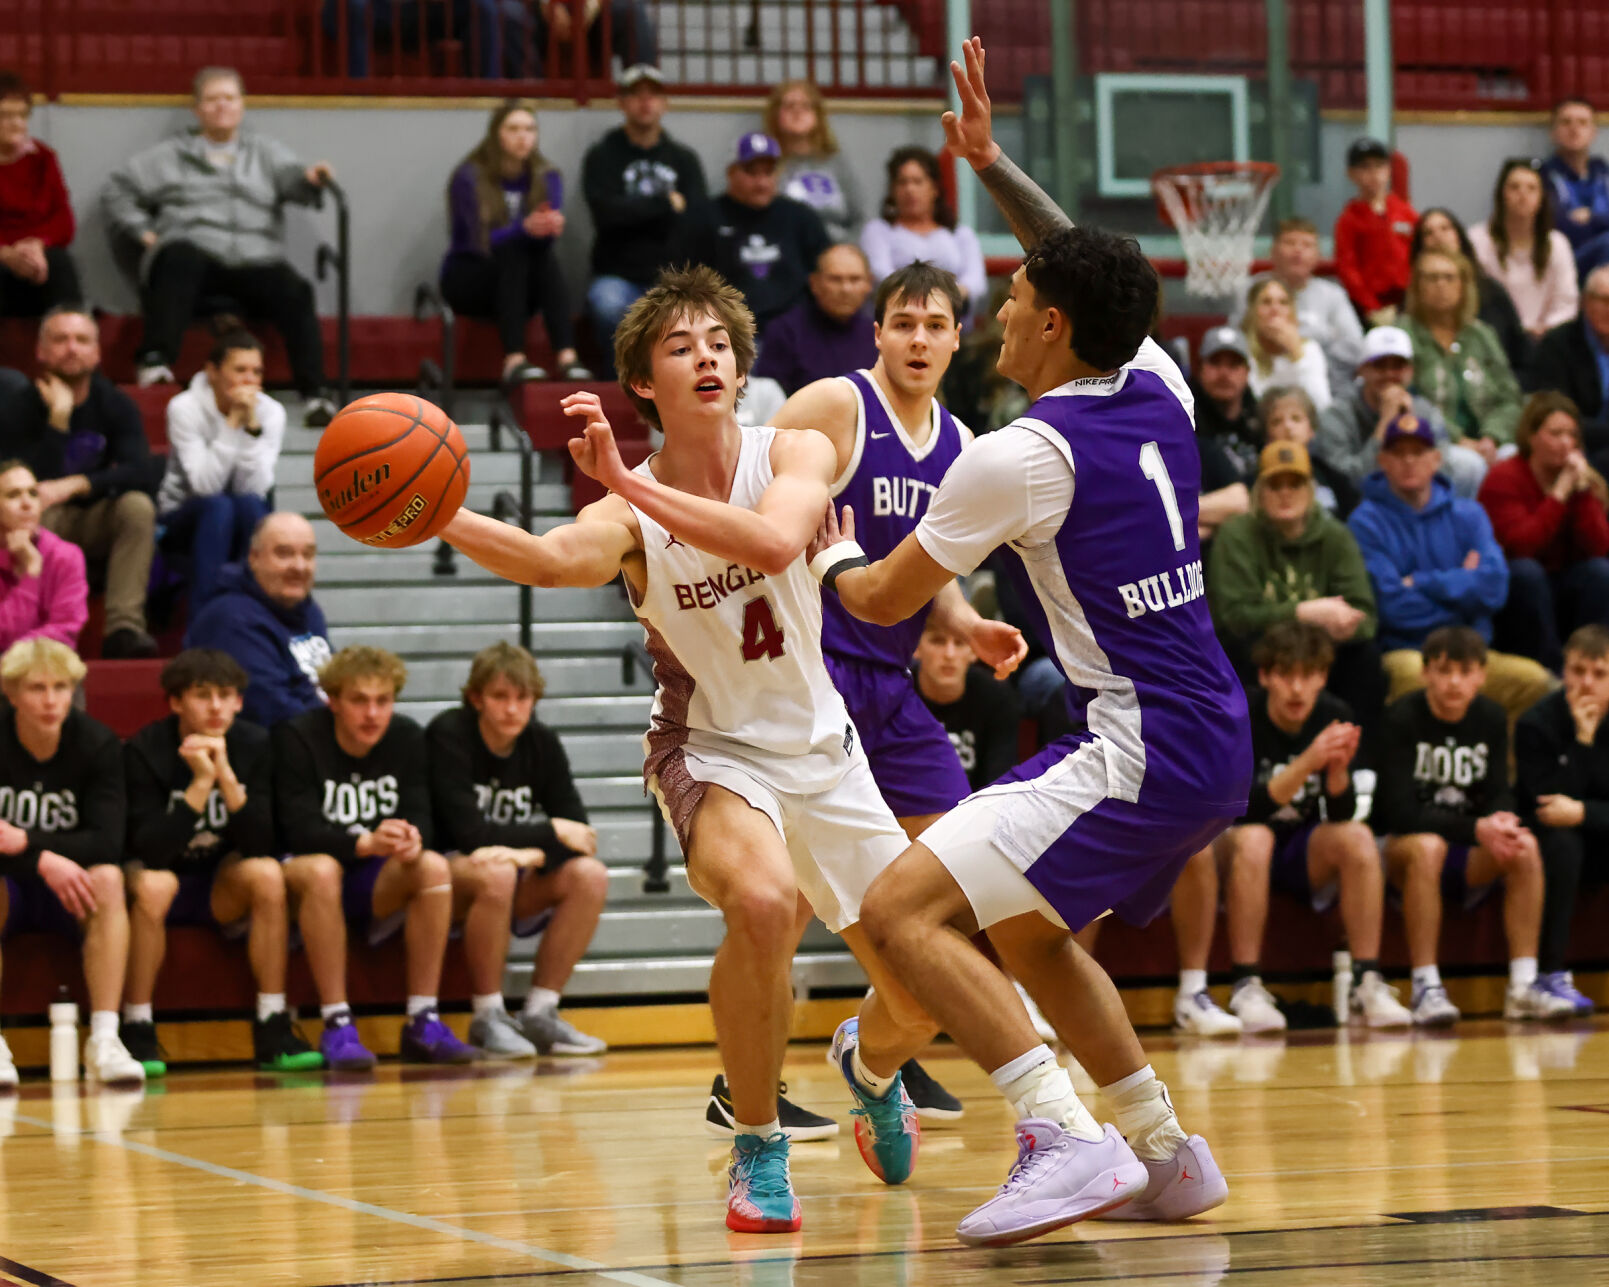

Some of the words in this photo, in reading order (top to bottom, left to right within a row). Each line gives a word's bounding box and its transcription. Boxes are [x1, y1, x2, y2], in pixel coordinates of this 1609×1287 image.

[1075, 378, 1098, 387] NIKE
[398, 496, 425, 529] PRO
[873, 476, 939, 519] BUTT
[1139, 440, 1186, 552] 1
[739, 594, 786, 664] 4
